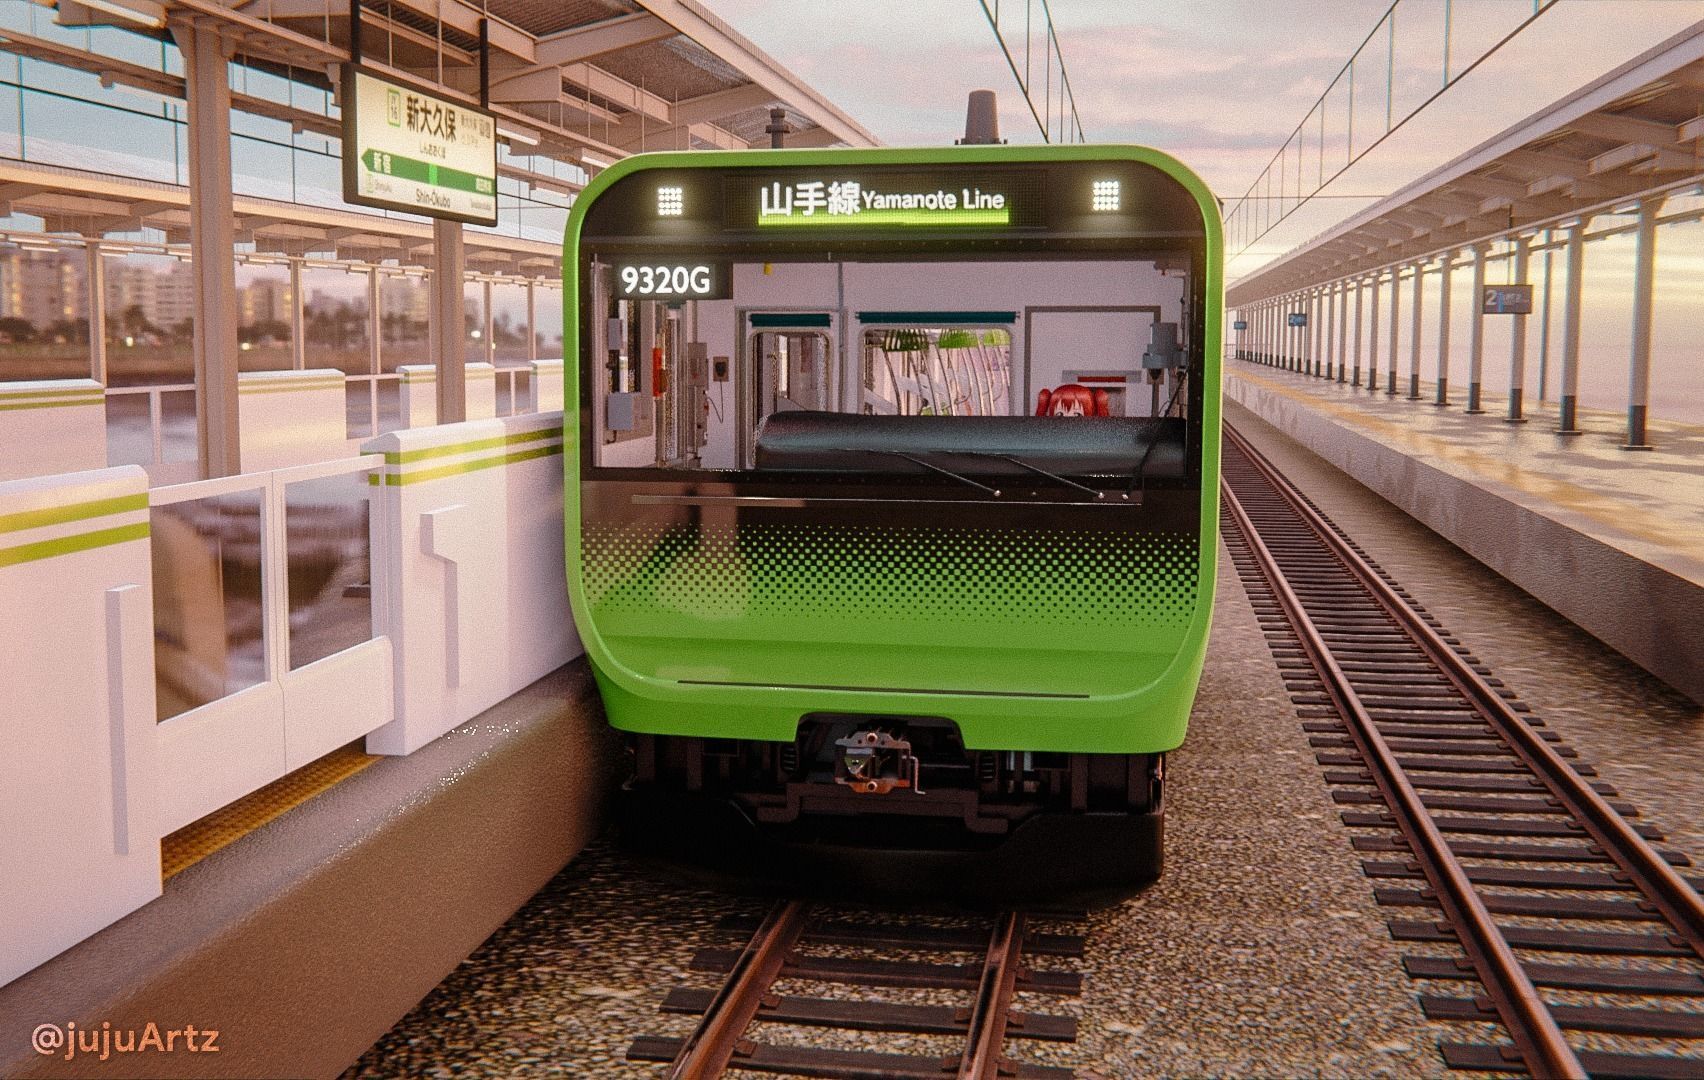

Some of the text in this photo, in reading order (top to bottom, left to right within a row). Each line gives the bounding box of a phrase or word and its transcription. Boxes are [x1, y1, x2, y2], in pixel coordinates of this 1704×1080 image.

[406, 95, 456, 142] 新大久保
[761, 182, 1005, 216] 山手線 Yamanote Line
[621, 266, 710, 294] 9320G
